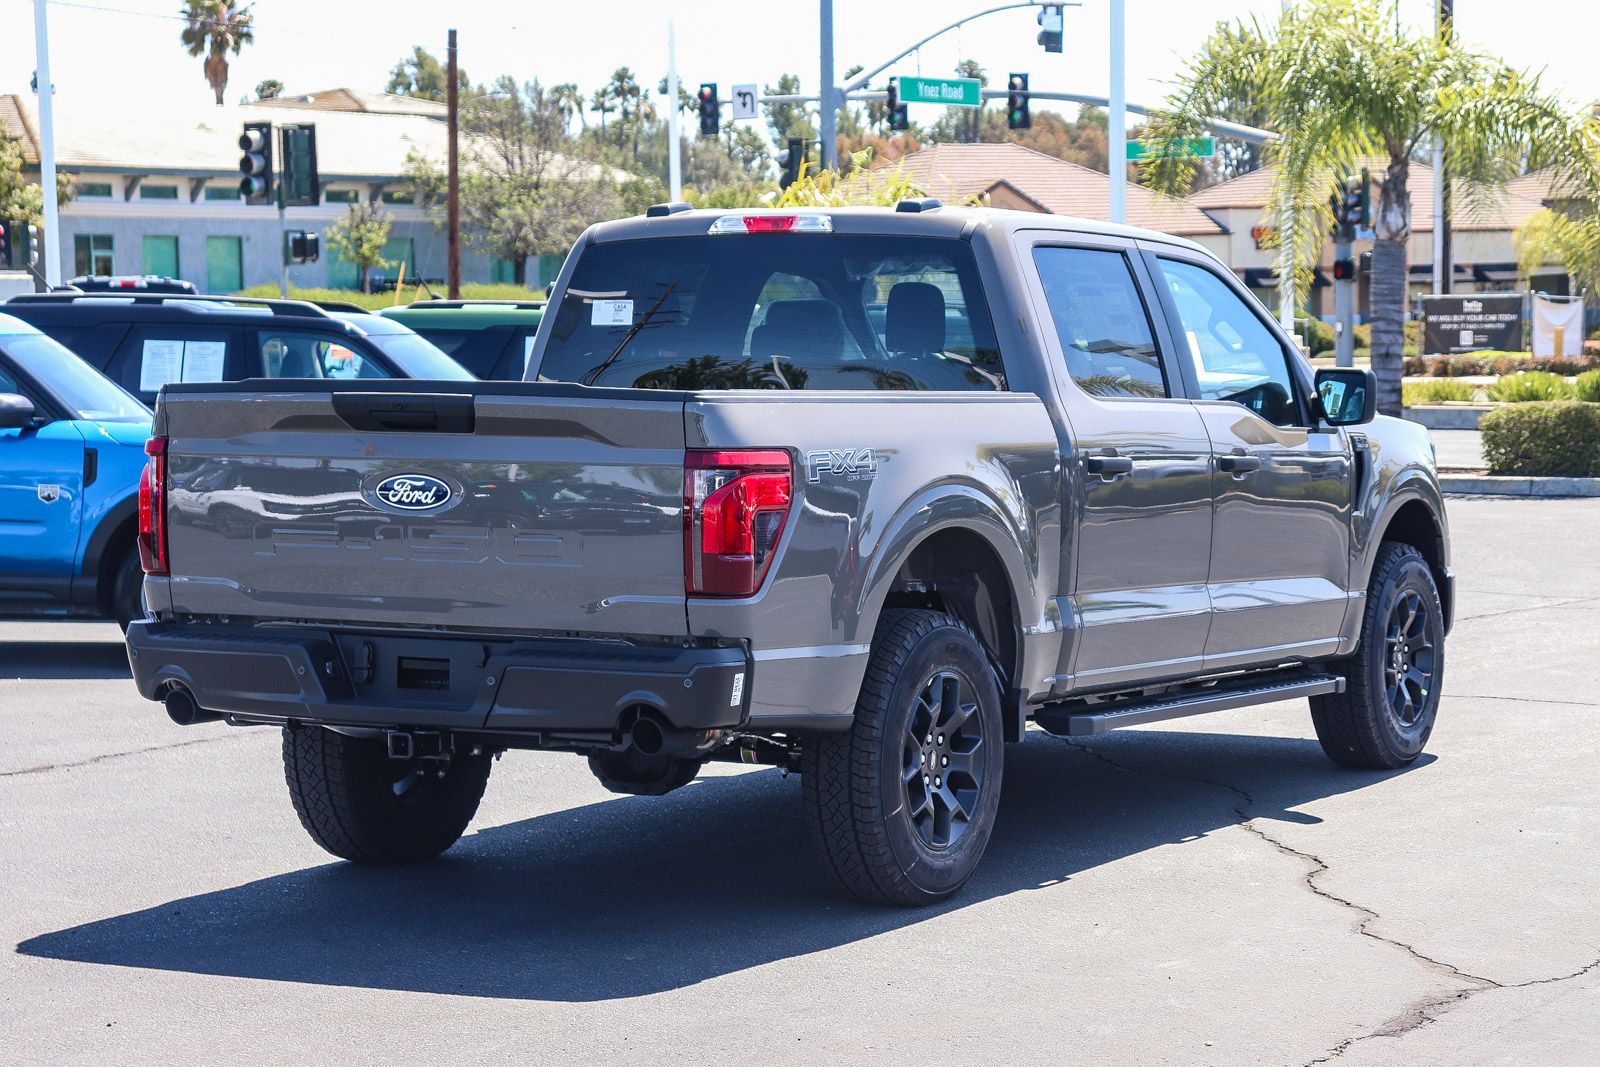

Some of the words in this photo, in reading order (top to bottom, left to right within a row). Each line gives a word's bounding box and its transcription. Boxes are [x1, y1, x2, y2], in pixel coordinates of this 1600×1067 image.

[918, 81, 939, 98] Ynez
[941, 82, 964, 100] Road
[806, 448, 879, 484] FX4
[388, 479, 437, 504] Ford
